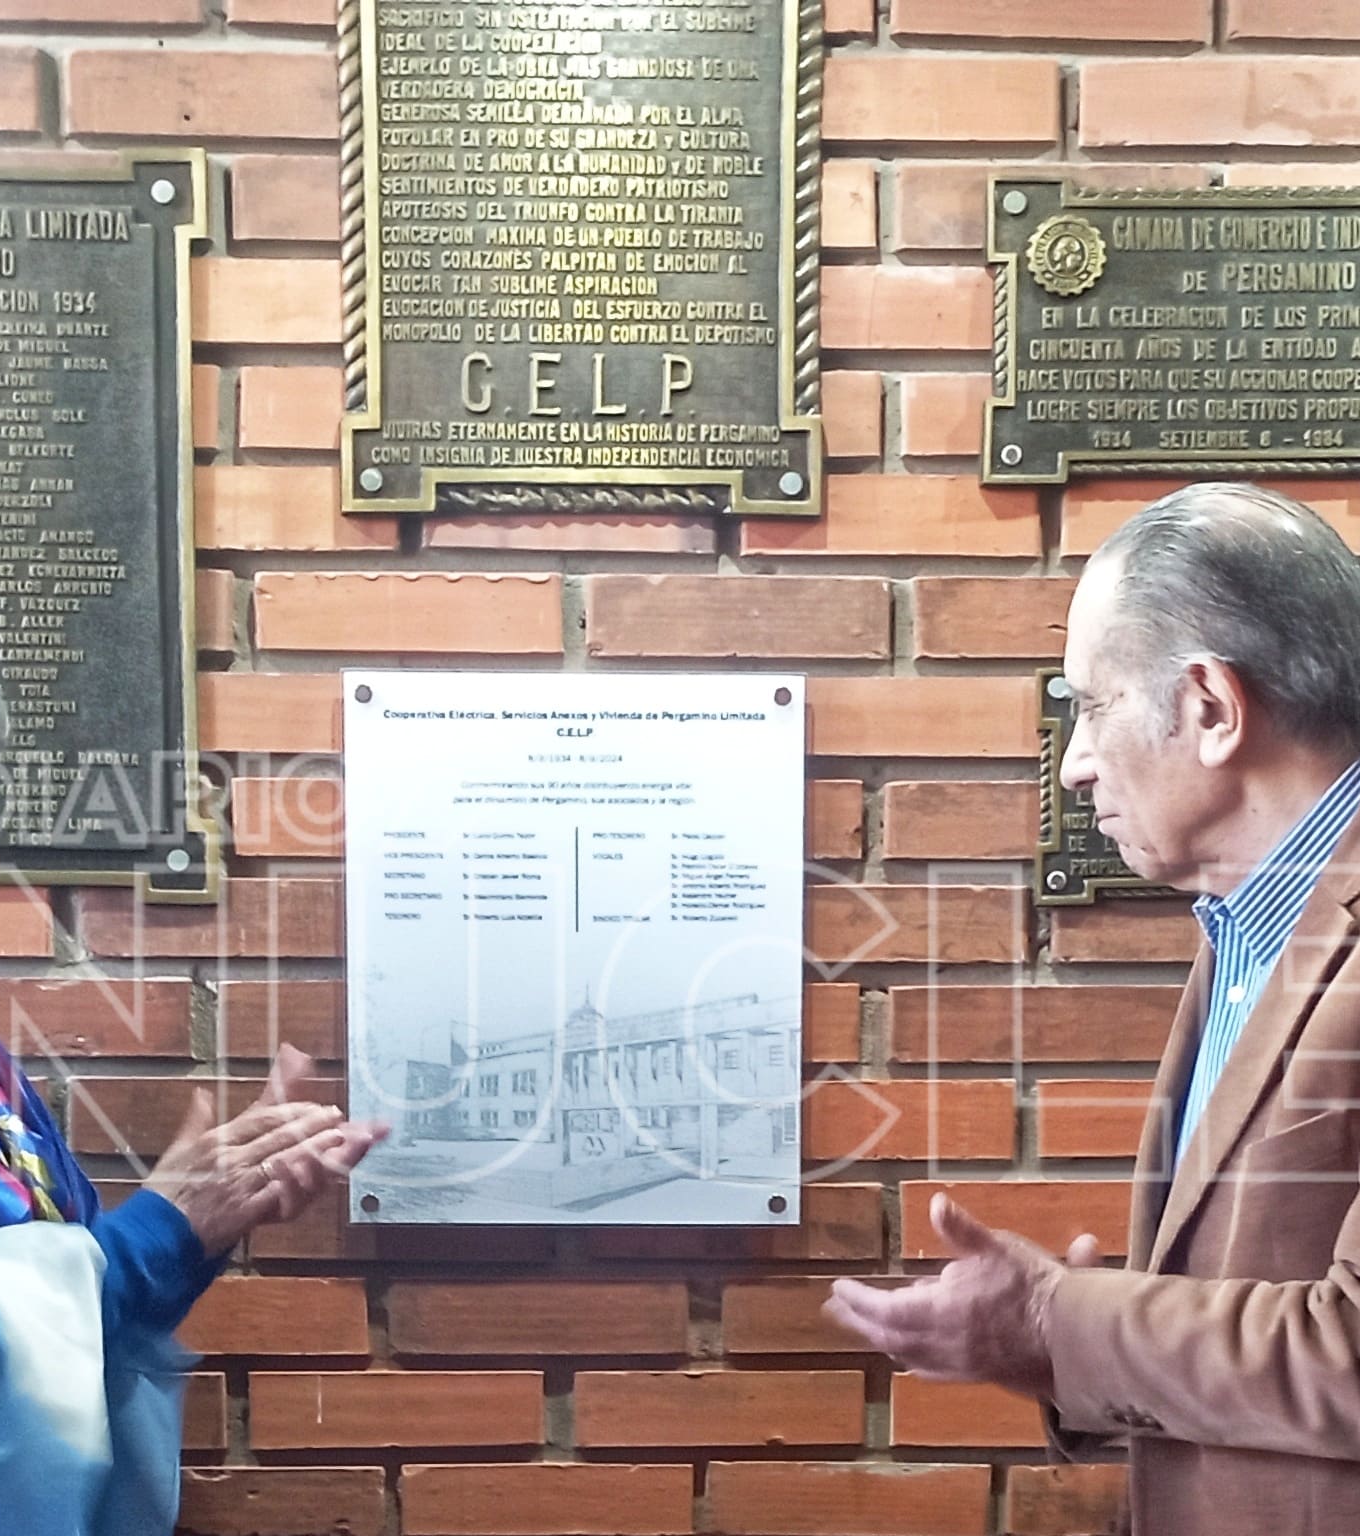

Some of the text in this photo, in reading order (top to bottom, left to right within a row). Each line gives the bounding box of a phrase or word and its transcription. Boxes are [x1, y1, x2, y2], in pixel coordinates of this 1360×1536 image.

[381, 176, 729, 199] SENTIMIENTOS DE VERDADERO PATRIOTISMO
[381, 200, 744, 225] APOTEOSIS DEL TRIUNFO CONTRA LA TIRANIA
[25, 209, 129, 241] LIMITADA
[1112, 214, 1185, 252] CAMARA
[1191, 215, 1215, 251] DE
[1220, 215, 1311, 251] COMERCIO
[1317, 216, 1327, 251] E
[381, 250, 748, 274] CUYOS CORAZONES PALPITAN DE EMOCION AL
[382, 275, 658, 295] EVOCAR TAN SUBLIME ASPIRACION
[1182, 261, 1356, 294] DE PERGAMINO
[53, 291, 97, 314] 1934
[1042, 306, 1064, 329] EN
[1077, 306, 1100, 329] LA
[1109, 305, 1228, 329] CELEBRACION
[1241, 306, 1265, 329] DE
[1274, 306, 1307, 329] LOS
[1029, 337, 1124, 361] CINCUENTA
[1137, 335, 1183, 360] AÑOS
[1193, 338, 1217, 361] DE
[1226, 338, 1247, 360] LA
[1261, 337, 1338, 359] ENTIDAD
[1017, 368, 1059, 391] HACE
[1063, 368, 1118, 391] VOTOS
[1119, 368, 1164, 392] PARA
[1168, 368, 1203, 392] QUE
[1205, 368, 1227, 391] SU
[1229, 368, 1308, 391] ACCIONAR
[1027, 399, 1081, 422] LOGRE
[1087, 399, 1161, 421] SIEMPRE
[1167, 399, 1200, 421] LOS
[1205, 399, 1298, 422] OBJETIVOS
[382, 421, 780, 444] VIVIRAS ETERNAMENTE EN LA HISTORIA DE PERGAMINO
[1092, 430, 1132, 448] 1934
[1159, 429, 1250, 448] SETIEMBRE
[371, 445, 790, 467] COMO INSIGNIA DE NUESTRA INDEPENDENCIA ECONOMICA
[383, 710, 445, 720] Cooperativa
[501, 711, 548, 720] Servicios
[550, 711, 588, 721] Anexos
[599, 711, 642, 721] Vivienda
[645, 712, 658, 721] de
[661, 712, 717, 724] Pergamino
[720, 712, 766, 721] Limitada
